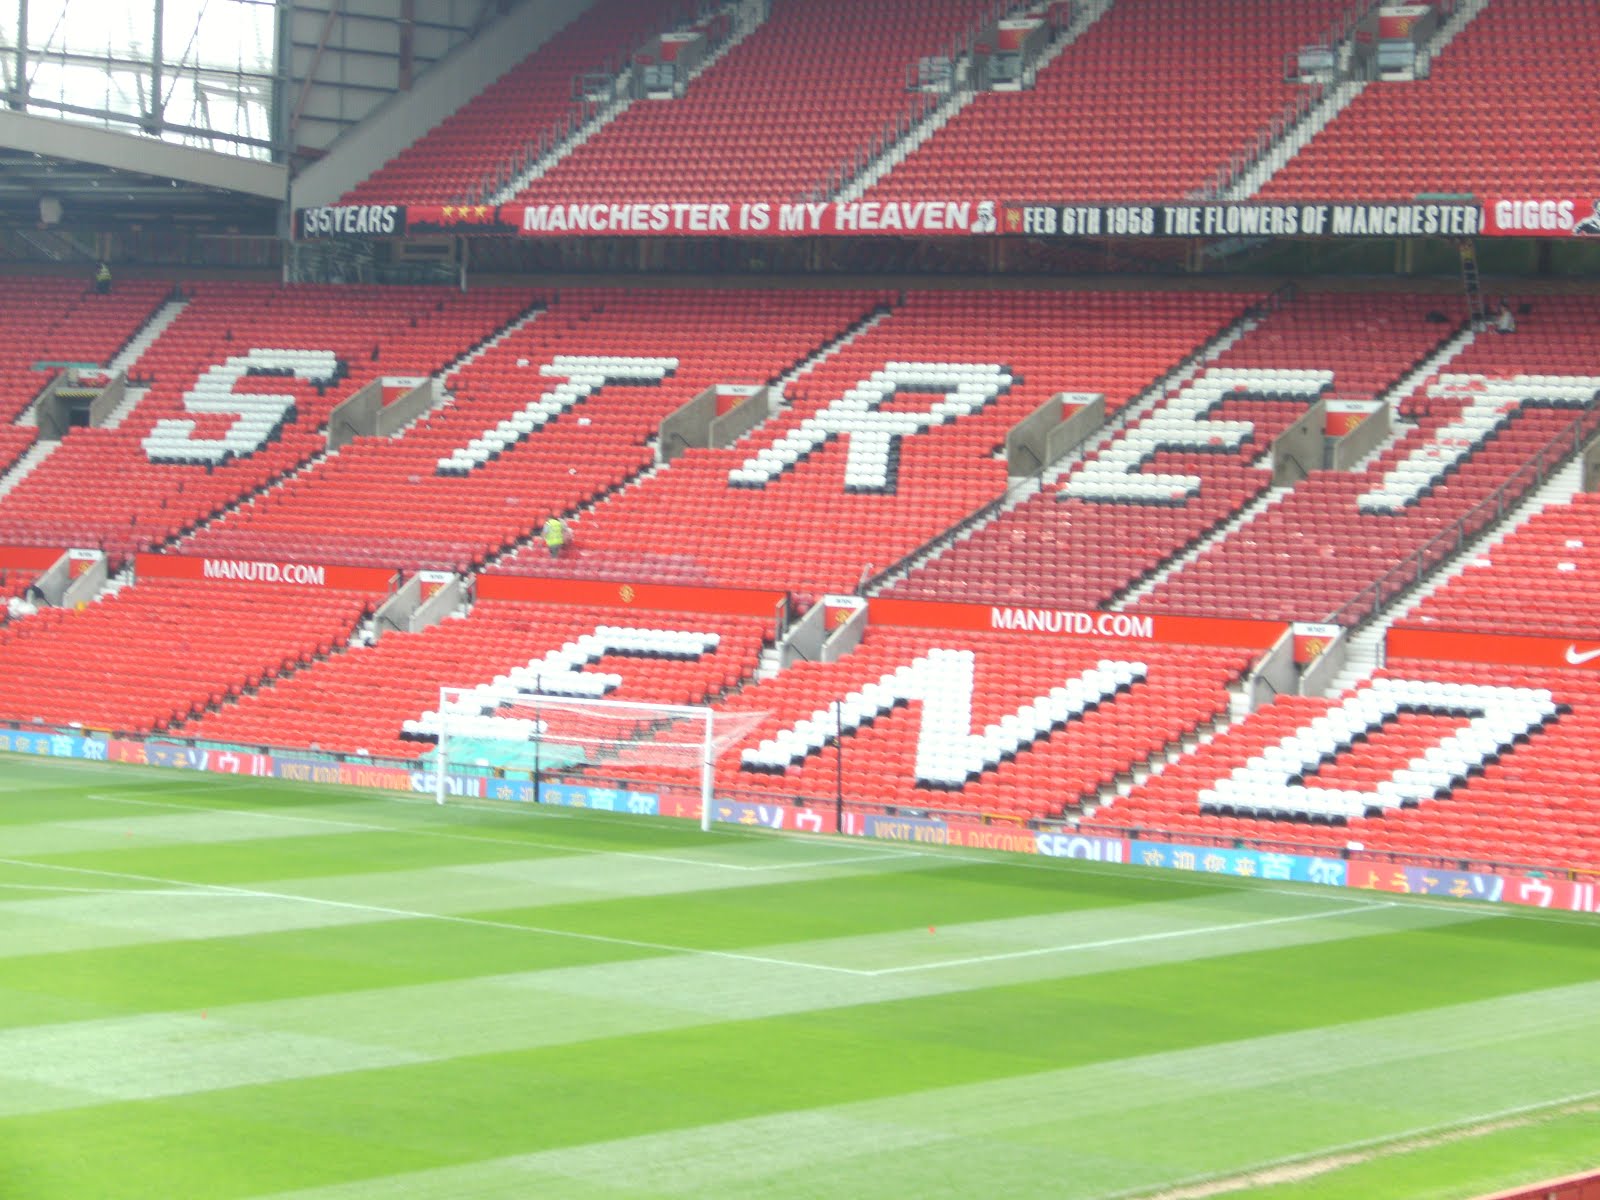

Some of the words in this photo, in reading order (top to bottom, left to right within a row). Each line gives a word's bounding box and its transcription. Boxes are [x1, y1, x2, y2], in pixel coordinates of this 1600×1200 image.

[523, 203, 730, 233] MANCHESTER
[738, 204, 770, 231] IS
[777, 203, 828, 232] MY
[834, 201, 972, 232] HEAVEN
[1022, 206, 1058, 235] FEB
[1062, 206, 1102, 236] 6TH
[1105, 206, 1156, 236] 1958
[1164, 206, 1200, 235] THE
[1205, 206, 1298, 236] FLOWERS
[1301, 206, 1329, 236] OF
[1333, 206, 1478, 235] MANCHESTER
[1495, 200, 1575, 230] GIGGS
[204, 558, 326, 586] MANUTD.COM
[991, 606, 1154, 639] MANUTD.COM
